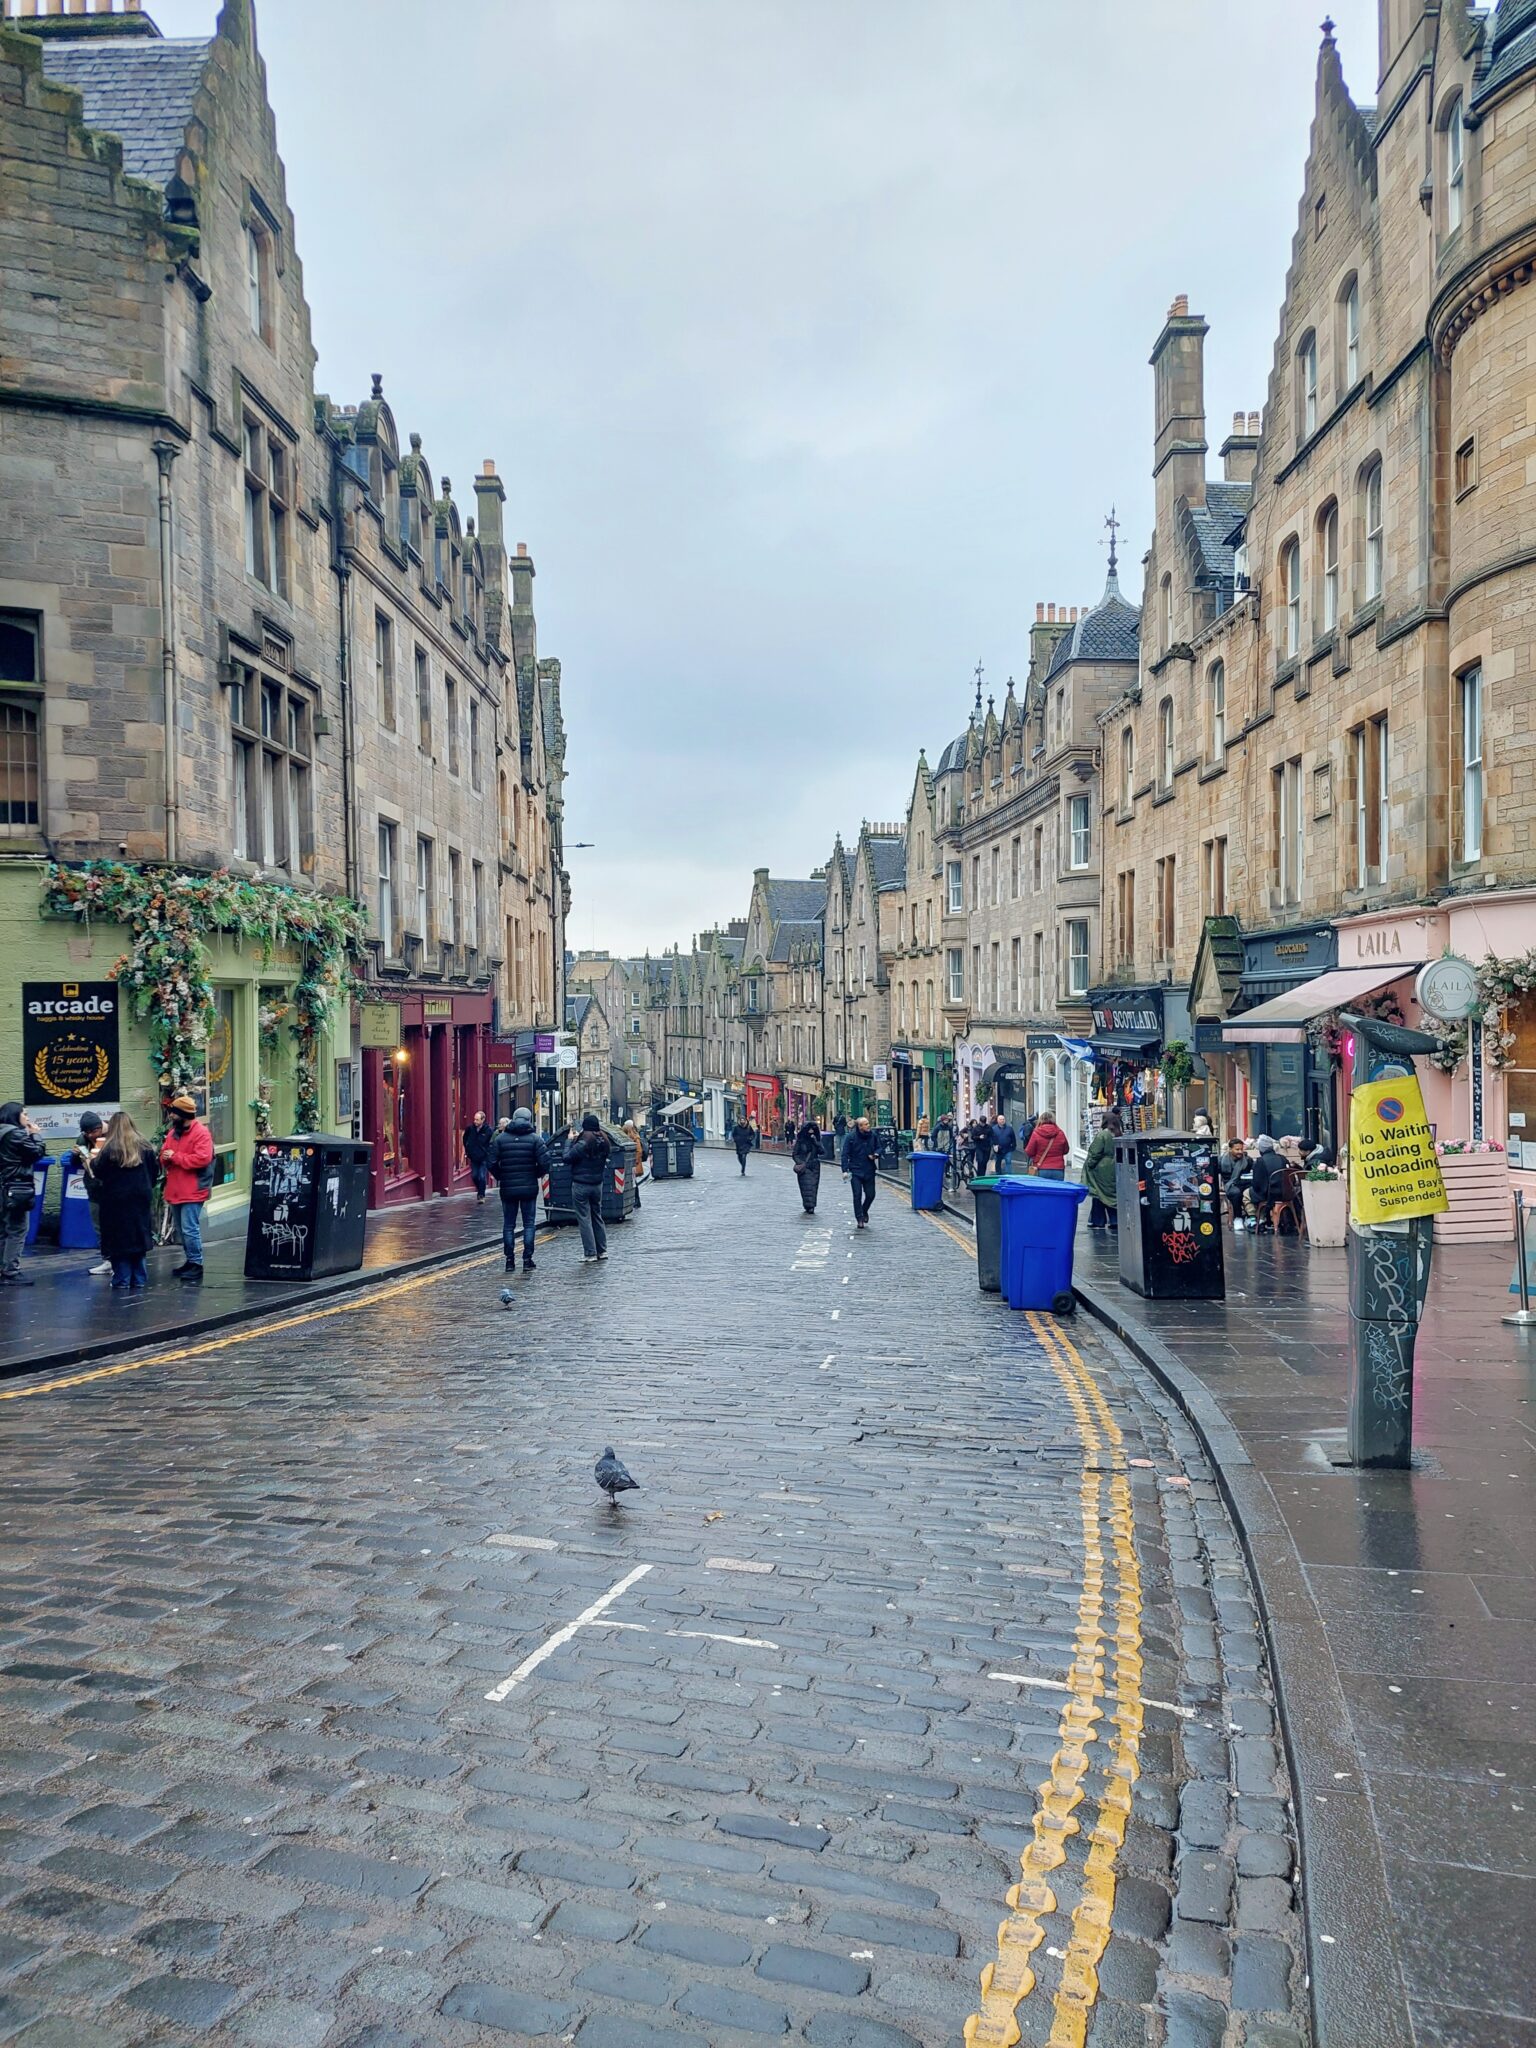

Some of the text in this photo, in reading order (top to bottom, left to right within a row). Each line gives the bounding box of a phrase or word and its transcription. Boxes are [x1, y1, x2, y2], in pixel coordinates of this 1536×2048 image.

[1357, 929, 1402, 958] LAILA
[1432, 980, 1473, 992] LAILA
[28, 995, 114, 1014] arcade
[1092, 1010, 1158, 1030] WE SCOTLAND
[52, 1055, 93, 1066] 15 years
[209, 1093, 228, 1103] cade
[37, 1120, 59, 1128] cade
[1380, 1123, 1431, 1142] Waitin
[1360, 1144, 1422, 1163] Loading
[1371, 1177, 1444, 1196] Parking Bays
[1379, 1188, 1442, 1207] Suspended
